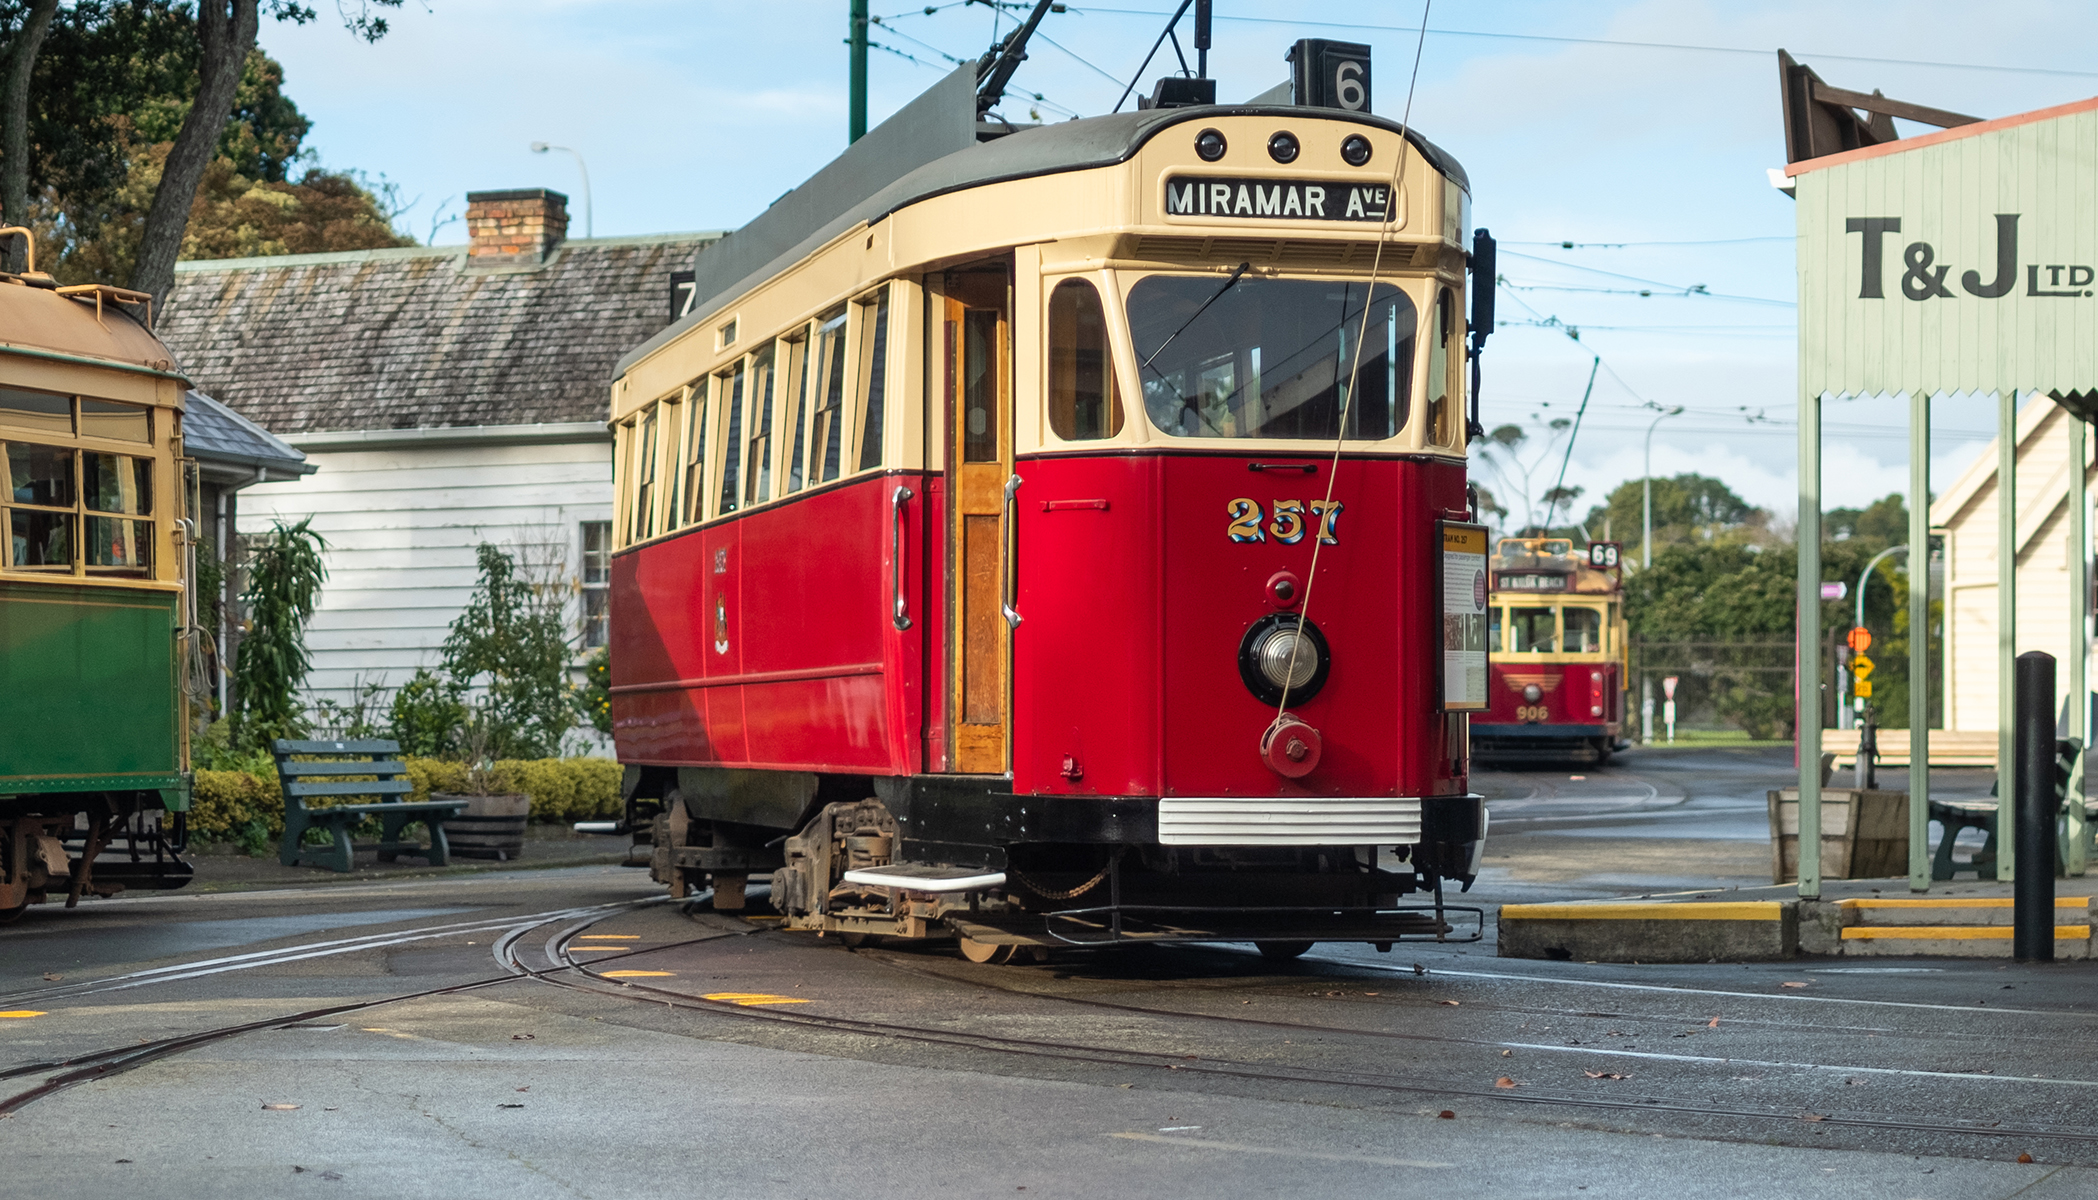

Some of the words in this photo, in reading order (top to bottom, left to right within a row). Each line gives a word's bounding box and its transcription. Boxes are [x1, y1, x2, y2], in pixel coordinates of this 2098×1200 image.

[1336, 60, 1365, 110] 6
[1167, 182, 1326, 217] MIRAMAR
[1845, 213, 2022, 301] T&J
[678, 282, 696, 317] 7
[1227, 497, 1344, 545] 257
[1591, 544, 1618, 567] 69
[1516, 706, 1549, 720] 906
